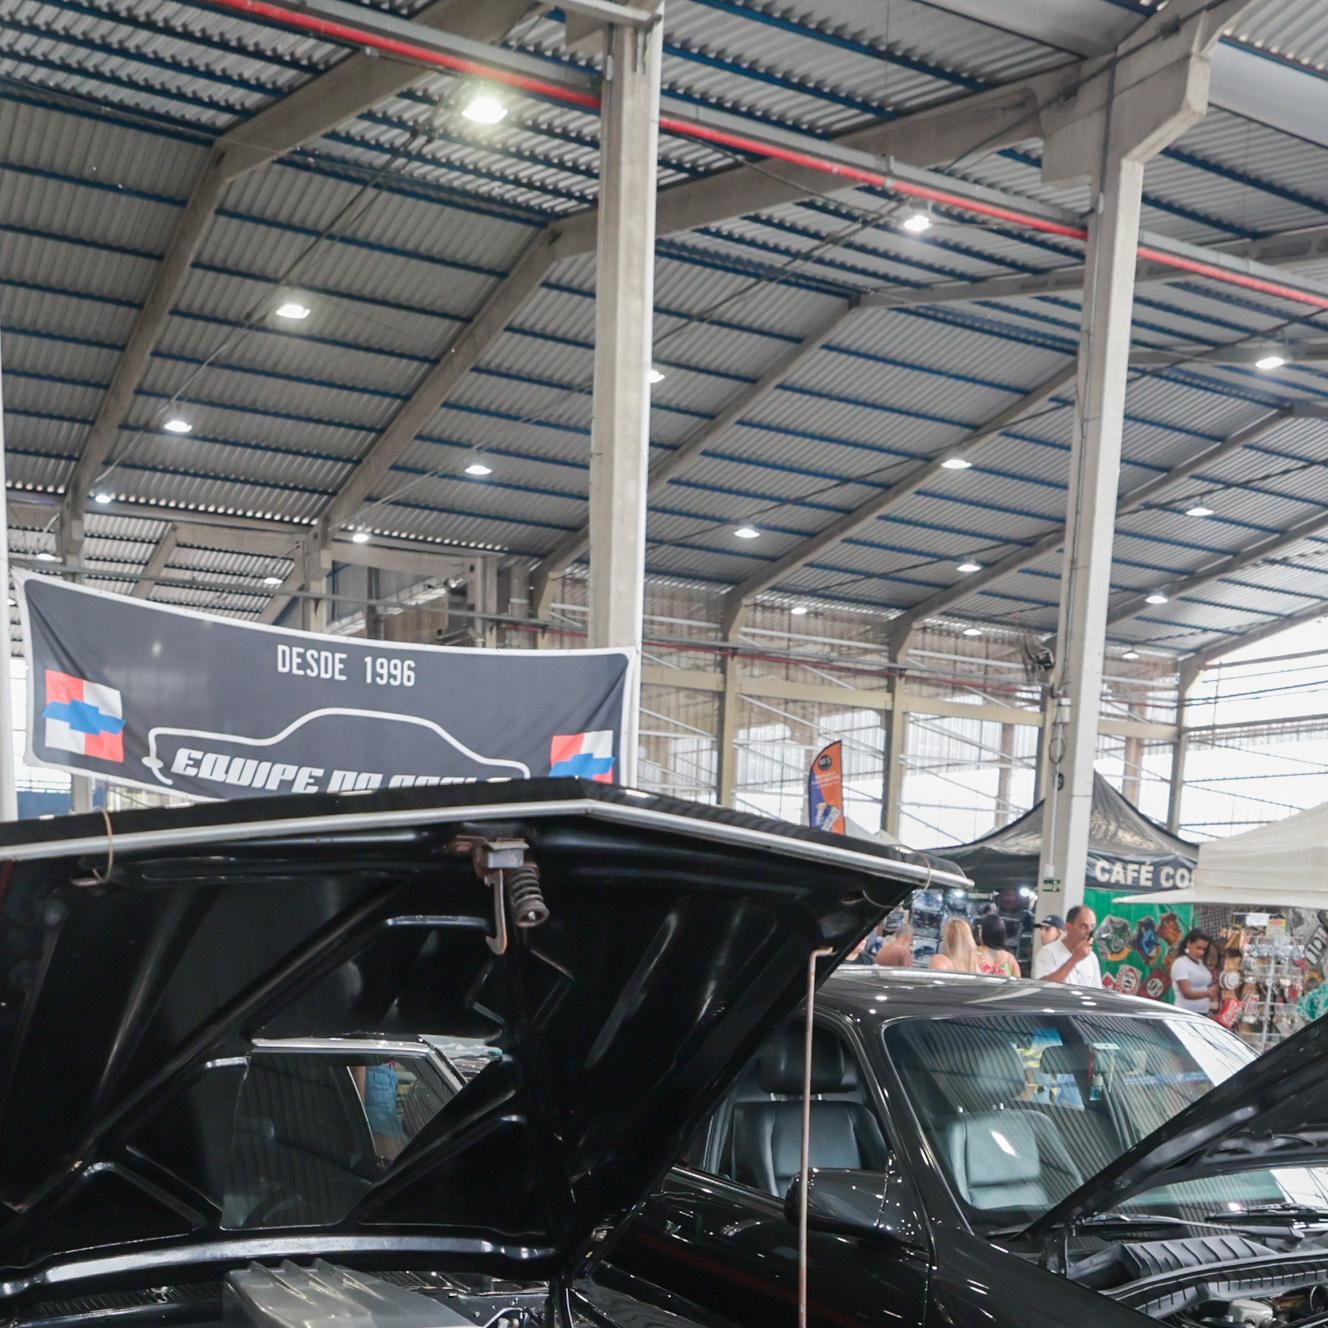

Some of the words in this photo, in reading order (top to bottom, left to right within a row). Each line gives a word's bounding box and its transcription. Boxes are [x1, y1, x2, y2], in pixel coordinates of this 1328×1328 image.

[276, 643, 348, 682] DESDE
[363, 654, 417, 687] 1996
[171, 747, 325, 795] EQUIPE
[1094, 859, 1155, 887] CAFÉ
[1159, 865, 1196, 889] CO
